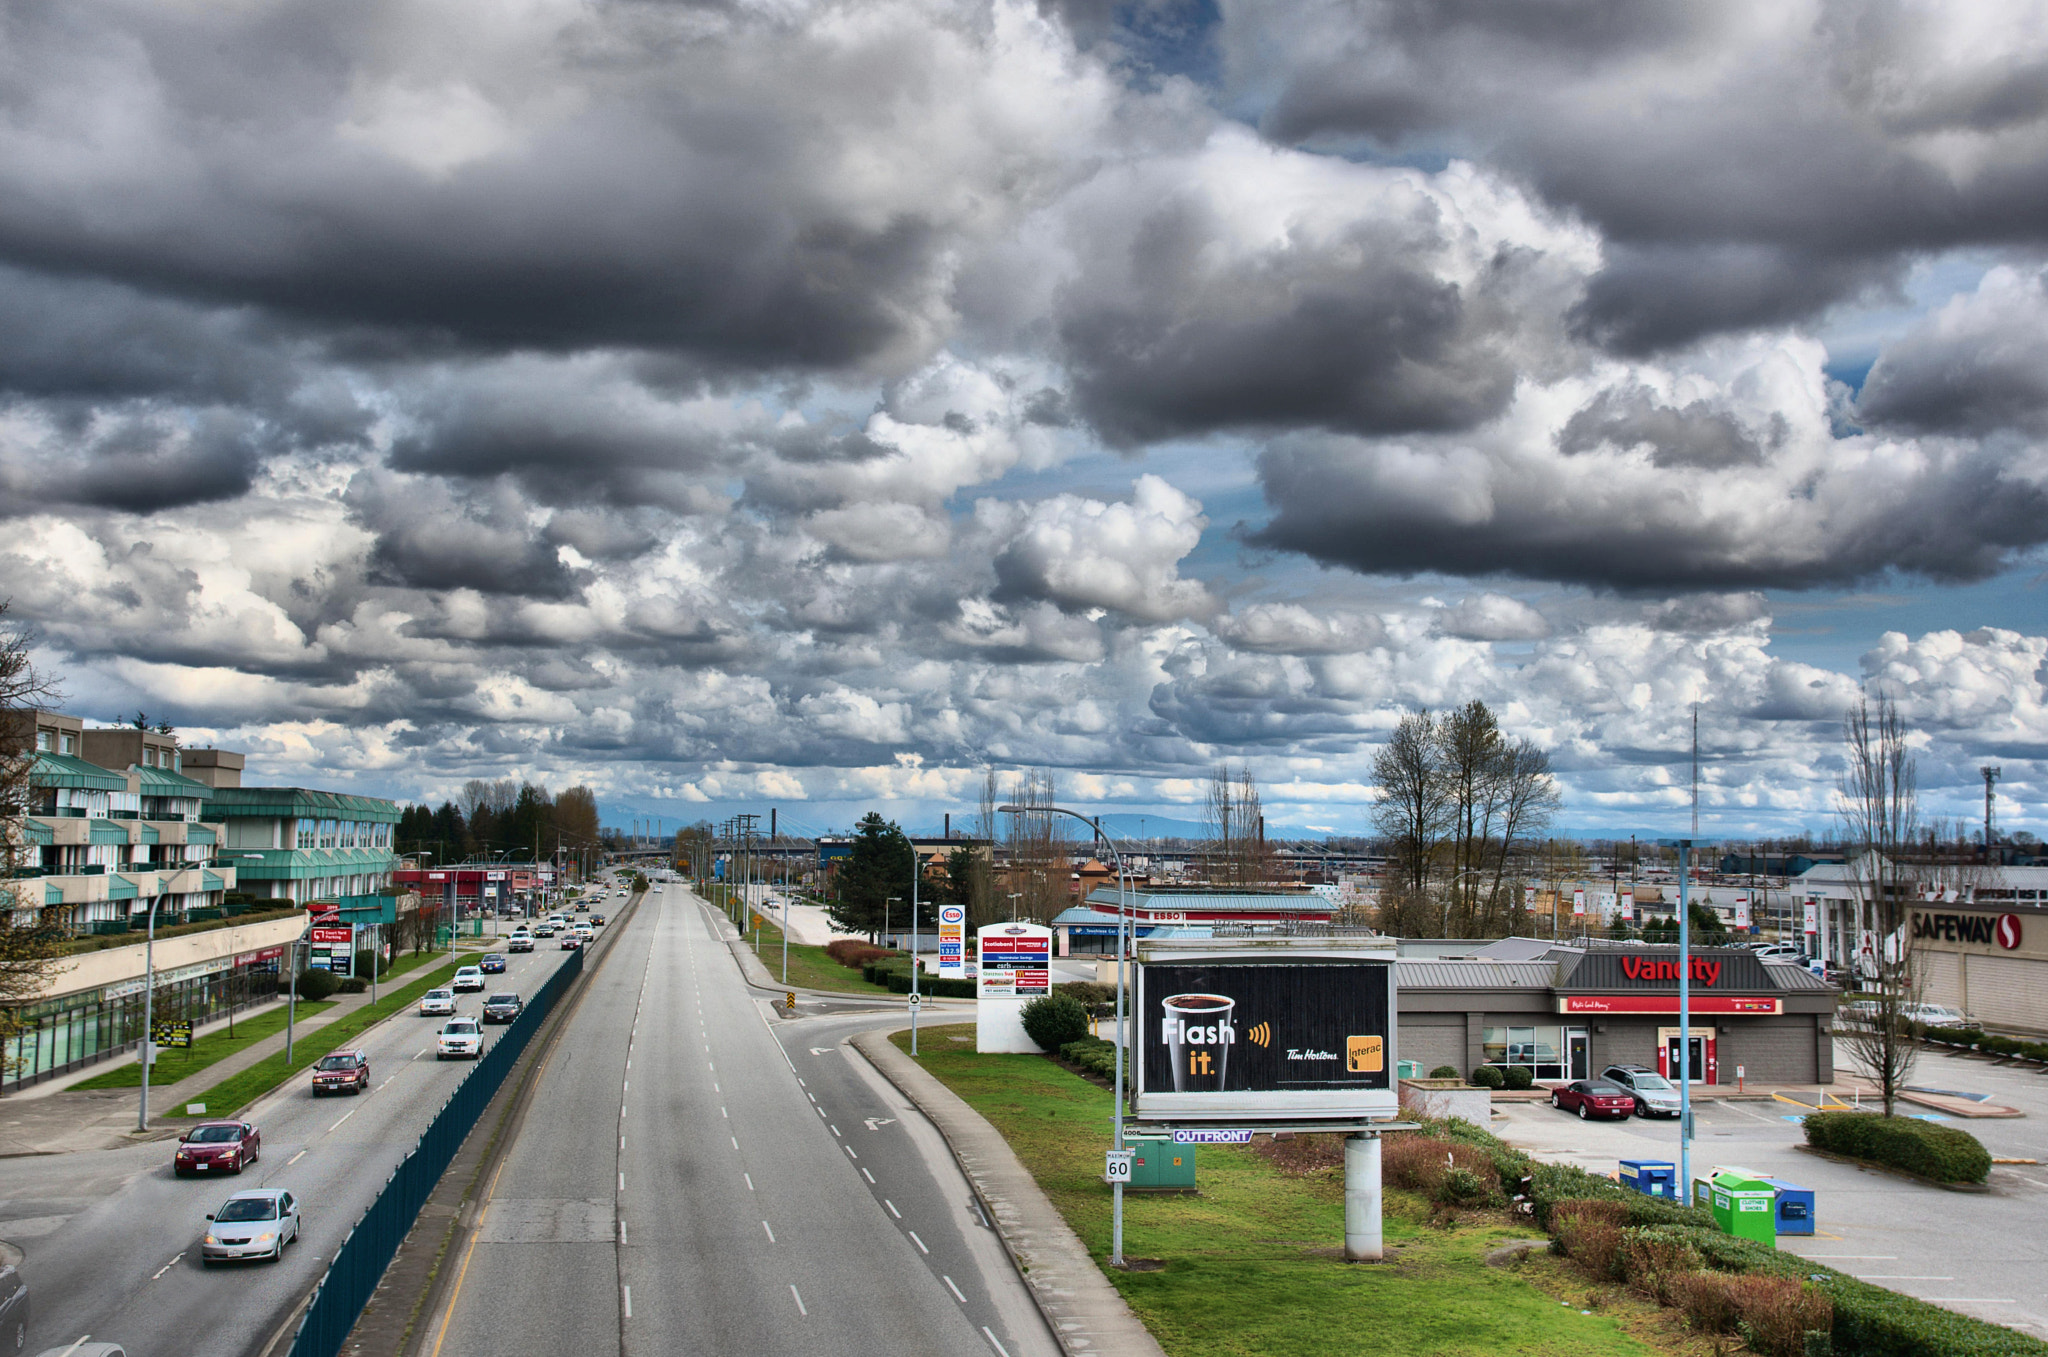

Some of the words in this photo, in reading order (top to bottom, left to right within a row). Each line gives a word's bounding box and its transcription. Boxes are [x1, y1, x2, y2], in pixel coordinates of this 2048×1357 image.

[1154, 912, 1180, 920] ESSO
[1912, 912, 1997, 943] SAFEWAY
[1622, 955, 1721, 987] Vancity
[1162, 1017, 1235, 1045] Flash
[1287, 1049, 1303, 1060] Tim
[1304, 1049, 1338, 1060] Hortons
[1349, 1044, 1381, 1058] Interac
[1190, 1050, 1215, 1075] it.
[1176, 1129, 1250, 1142] OUTFRONT
[1109, 1162, 1128, 1175] 60
